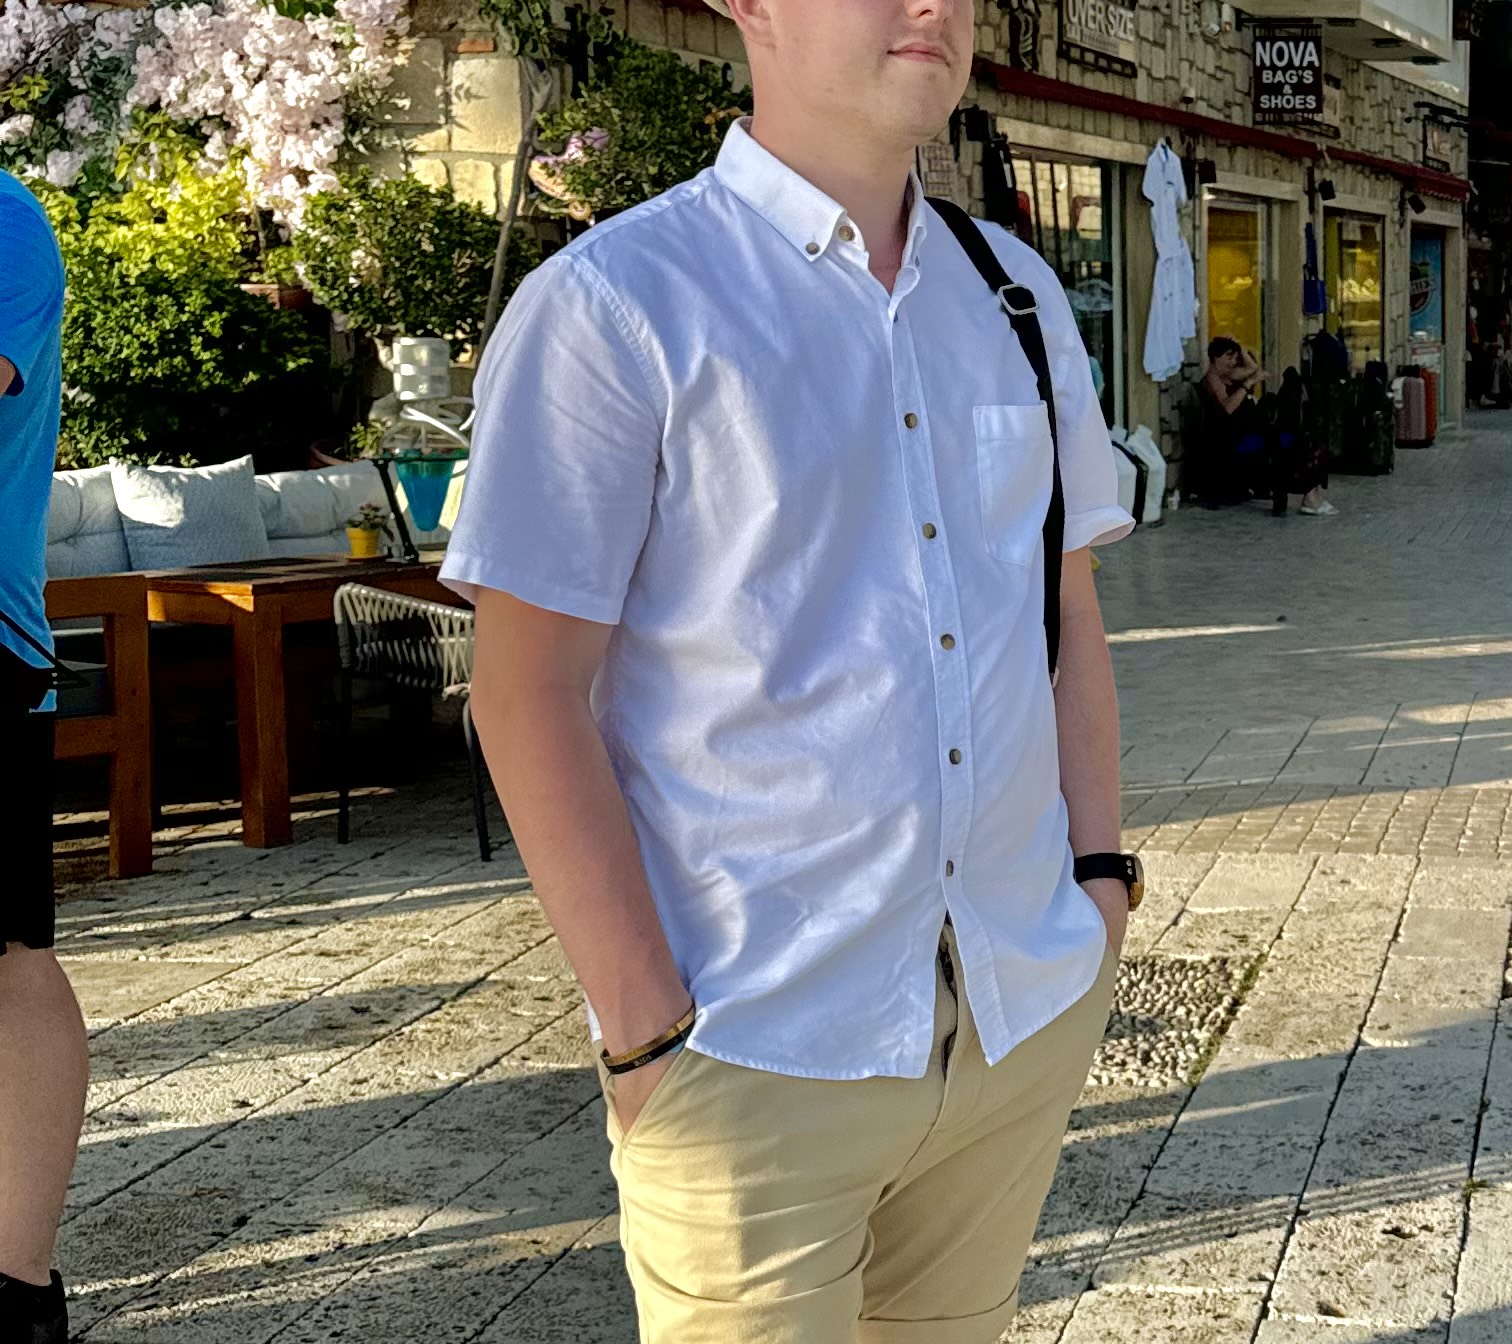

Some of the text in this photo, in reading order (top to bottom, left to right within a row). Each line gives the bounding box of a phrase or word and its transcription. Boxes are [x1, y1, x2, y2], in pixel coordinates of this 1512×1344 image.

[1255, 40, 1320, 67] NOVA
[1262, 69, 1315, 84] BAG'S
[1282, 84, 1293, 94] &
[1260, 94, 1317, 109] SHOES
